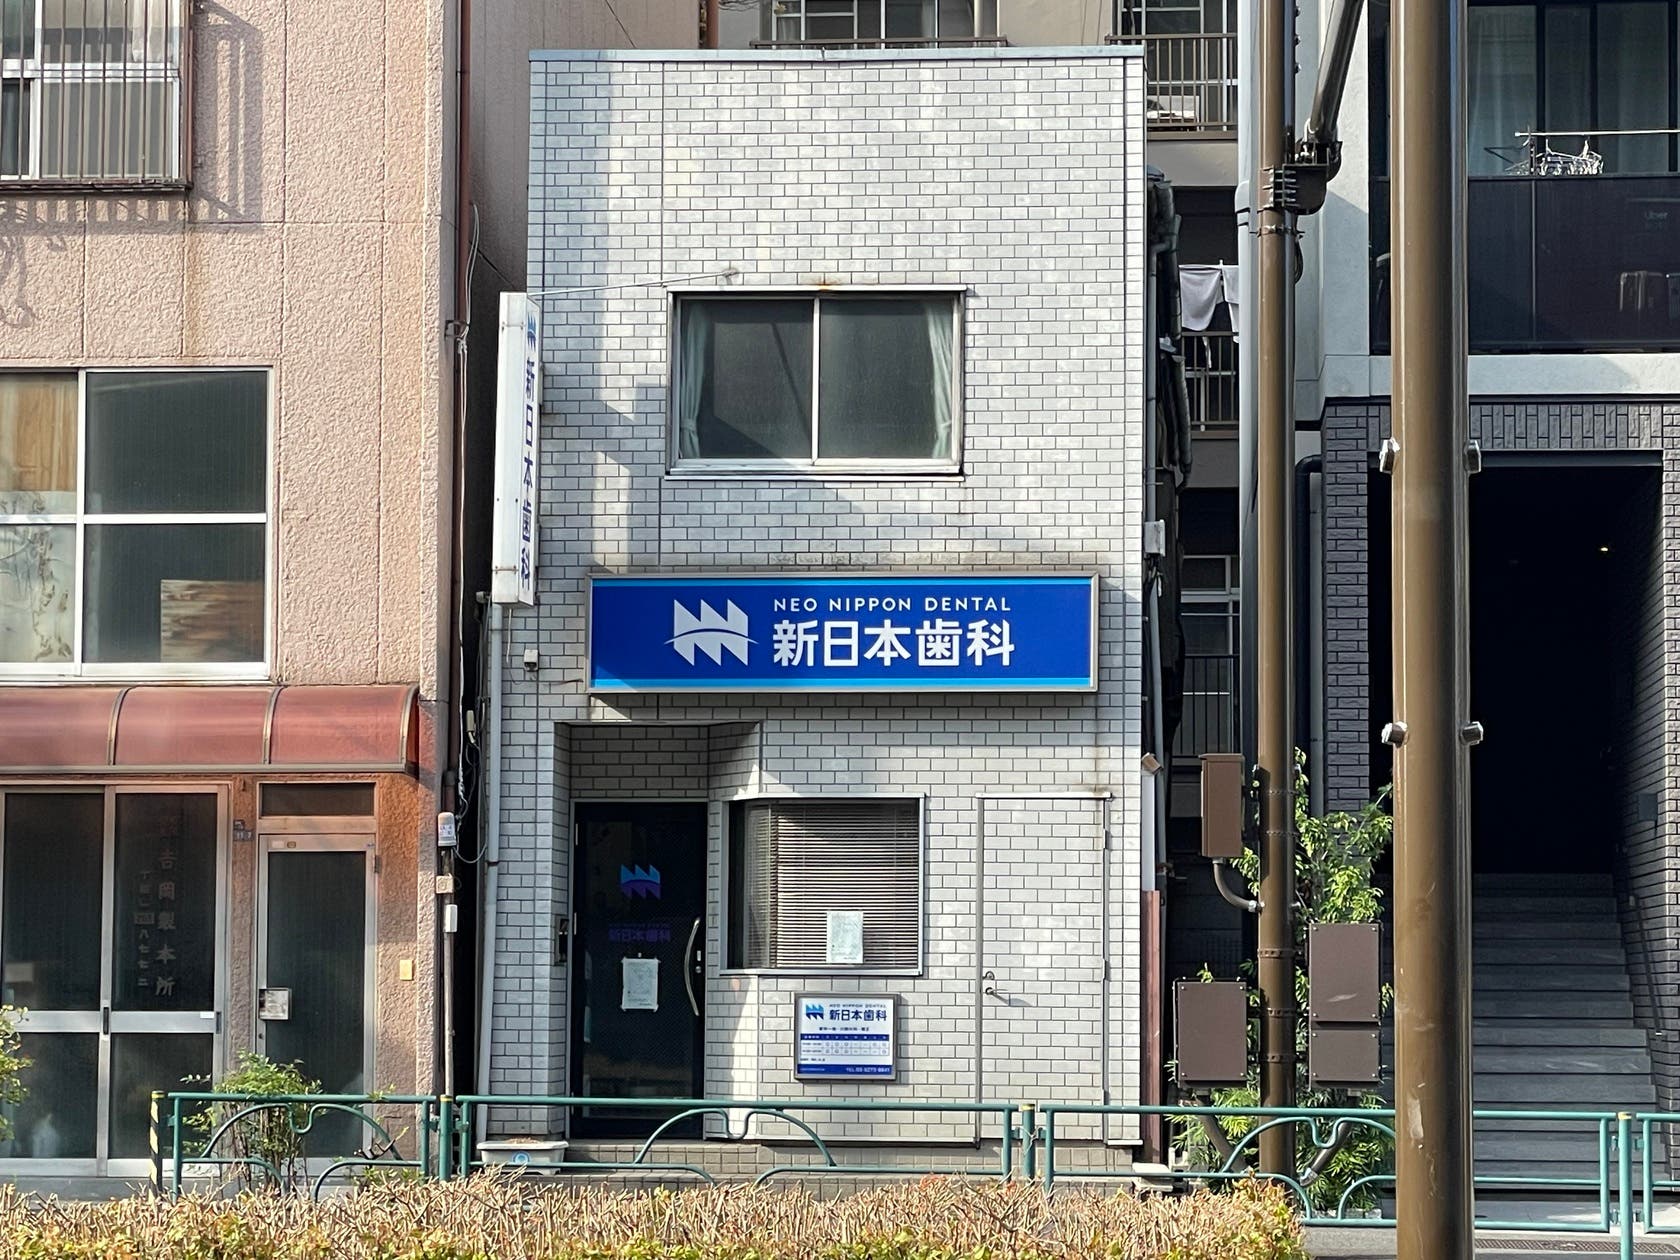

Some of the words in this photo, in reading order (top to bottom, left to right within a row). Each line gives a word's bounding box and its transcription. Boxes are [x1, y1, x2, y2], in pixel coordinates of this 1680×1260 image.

[521, 356, 535, 591] 新日本歯科
[773, 598, 818, 612] NEO
[829, 597, 911, 612] NIPPON
[925, 597, 1011, 611] DENTAL
[773, 618, 1015, 667] 新日本歯科
[829, 1009, 887, 1021] 新日本歯科
